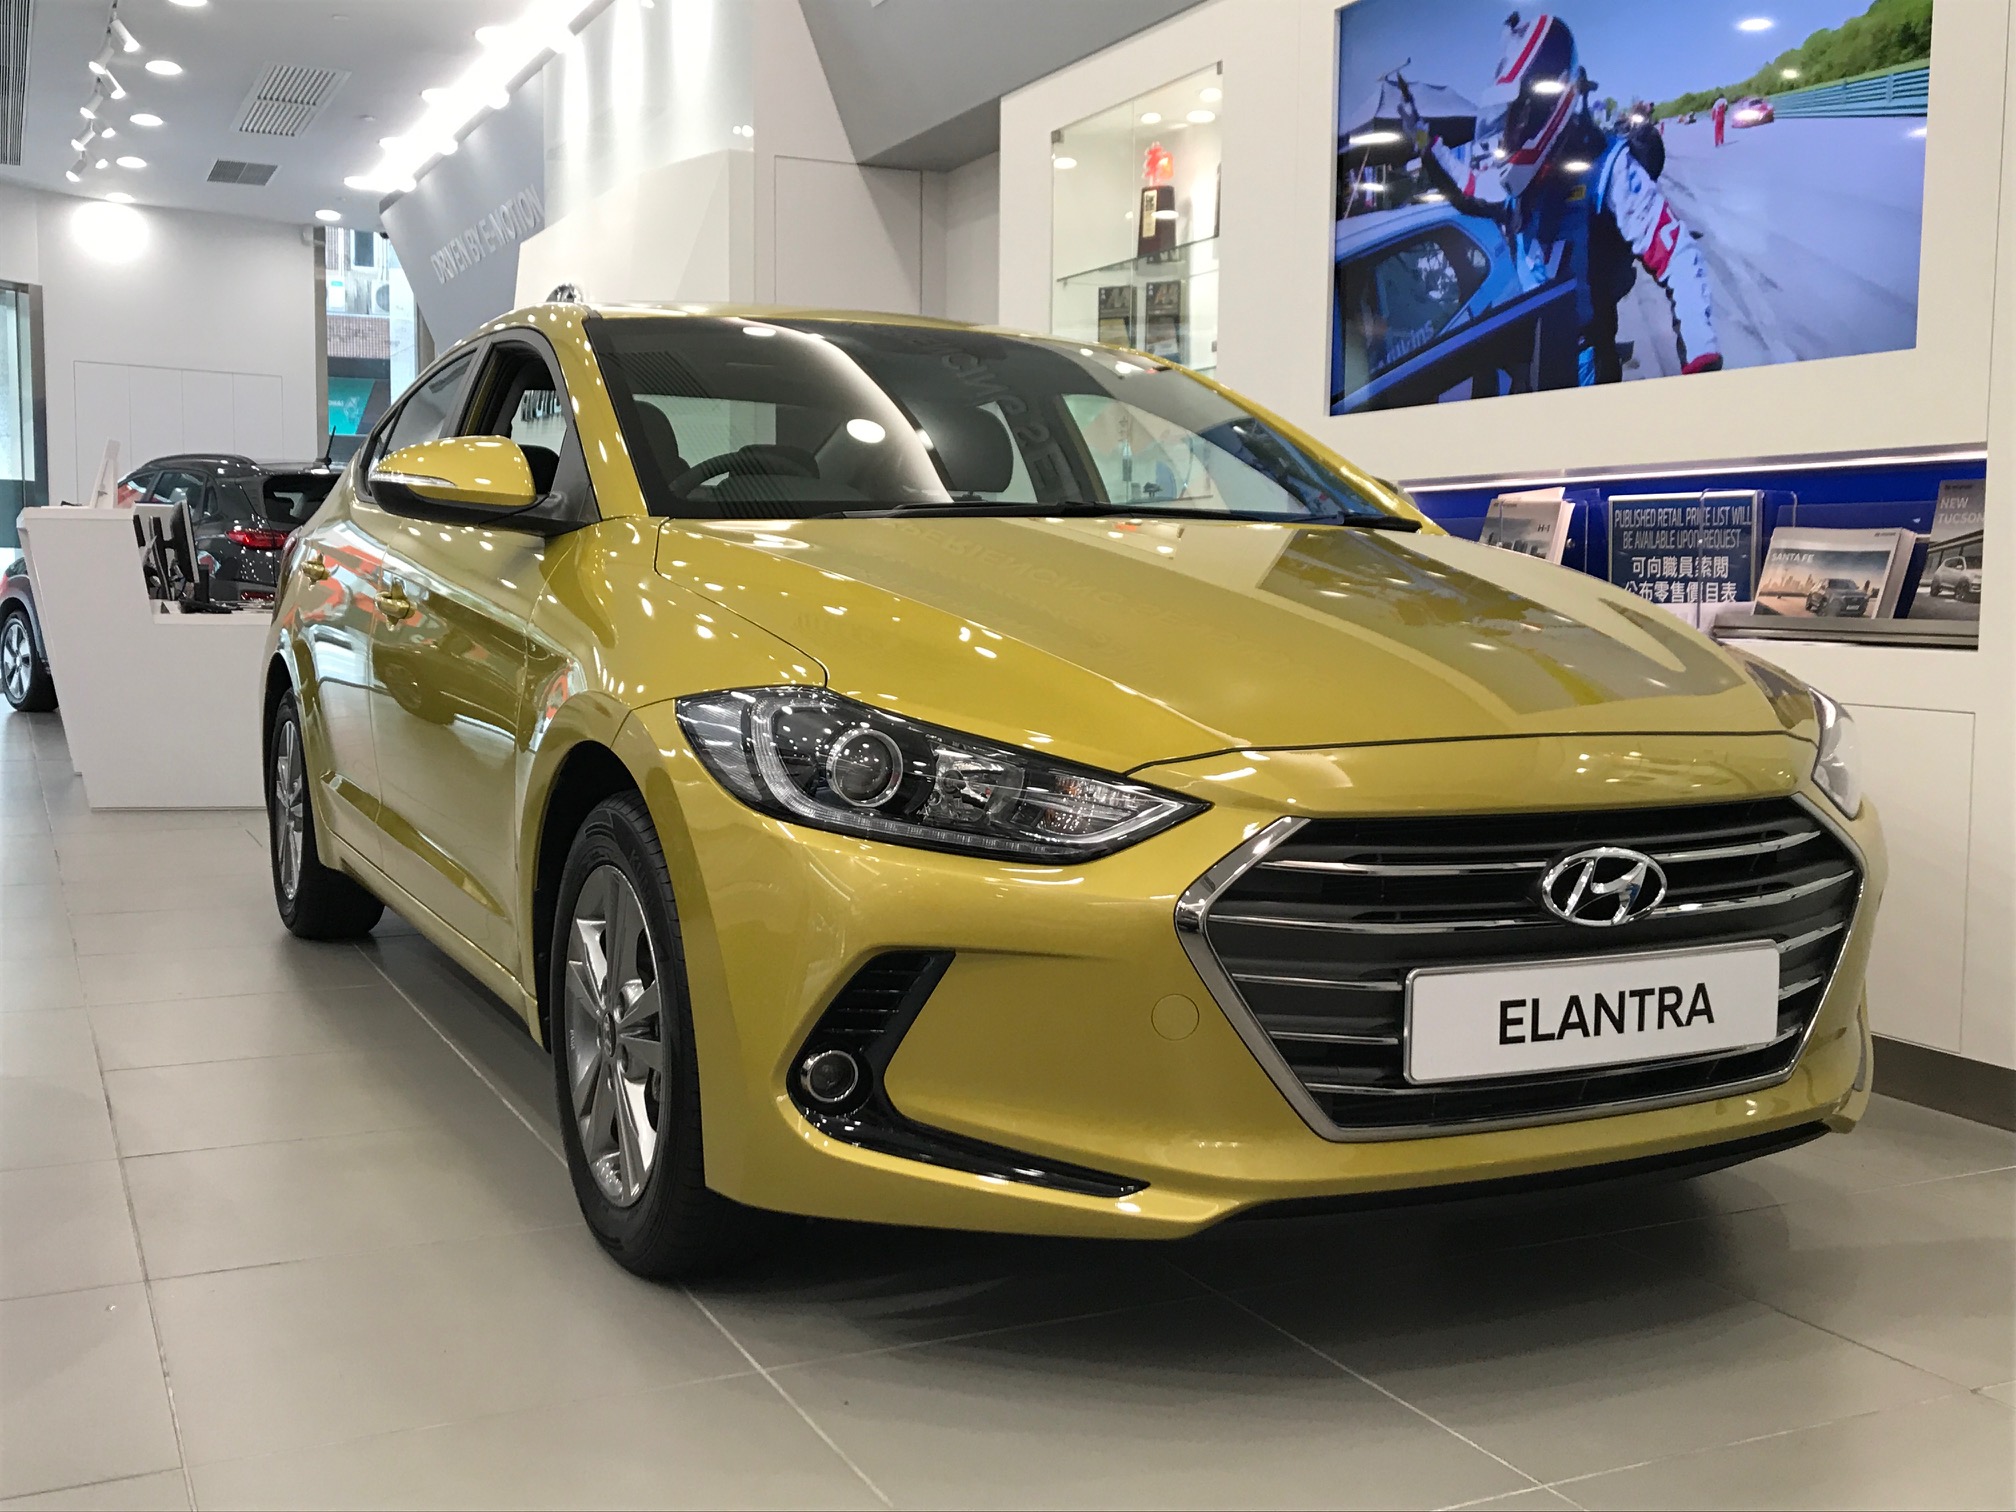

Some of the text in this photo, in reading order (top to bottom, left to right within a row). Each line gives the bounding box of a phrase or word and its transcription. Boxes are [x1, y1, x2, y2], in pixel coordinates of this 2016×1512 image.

[430, 237, 472, 284] DRIVEN
[1940, 497, 1968, 509] NEW
[1615, 509, 1655, 528] PUBLISHED
[1658, 508, 1683, 527] RETAIL
[1713, 507, 1729, 526] LIST
[1732, 506, 1752, 526] WILL
[1938, 512, 1985, 524] TUCSON
[1537, 524, 1551, 532] H-1
[1623, 528, 1741, 550] BE AVAILABLE UPON REQUEST
[1771, 552, 1815, 563] SANTA FE
[1500, 982, 1714, 1045] ELANTRA
